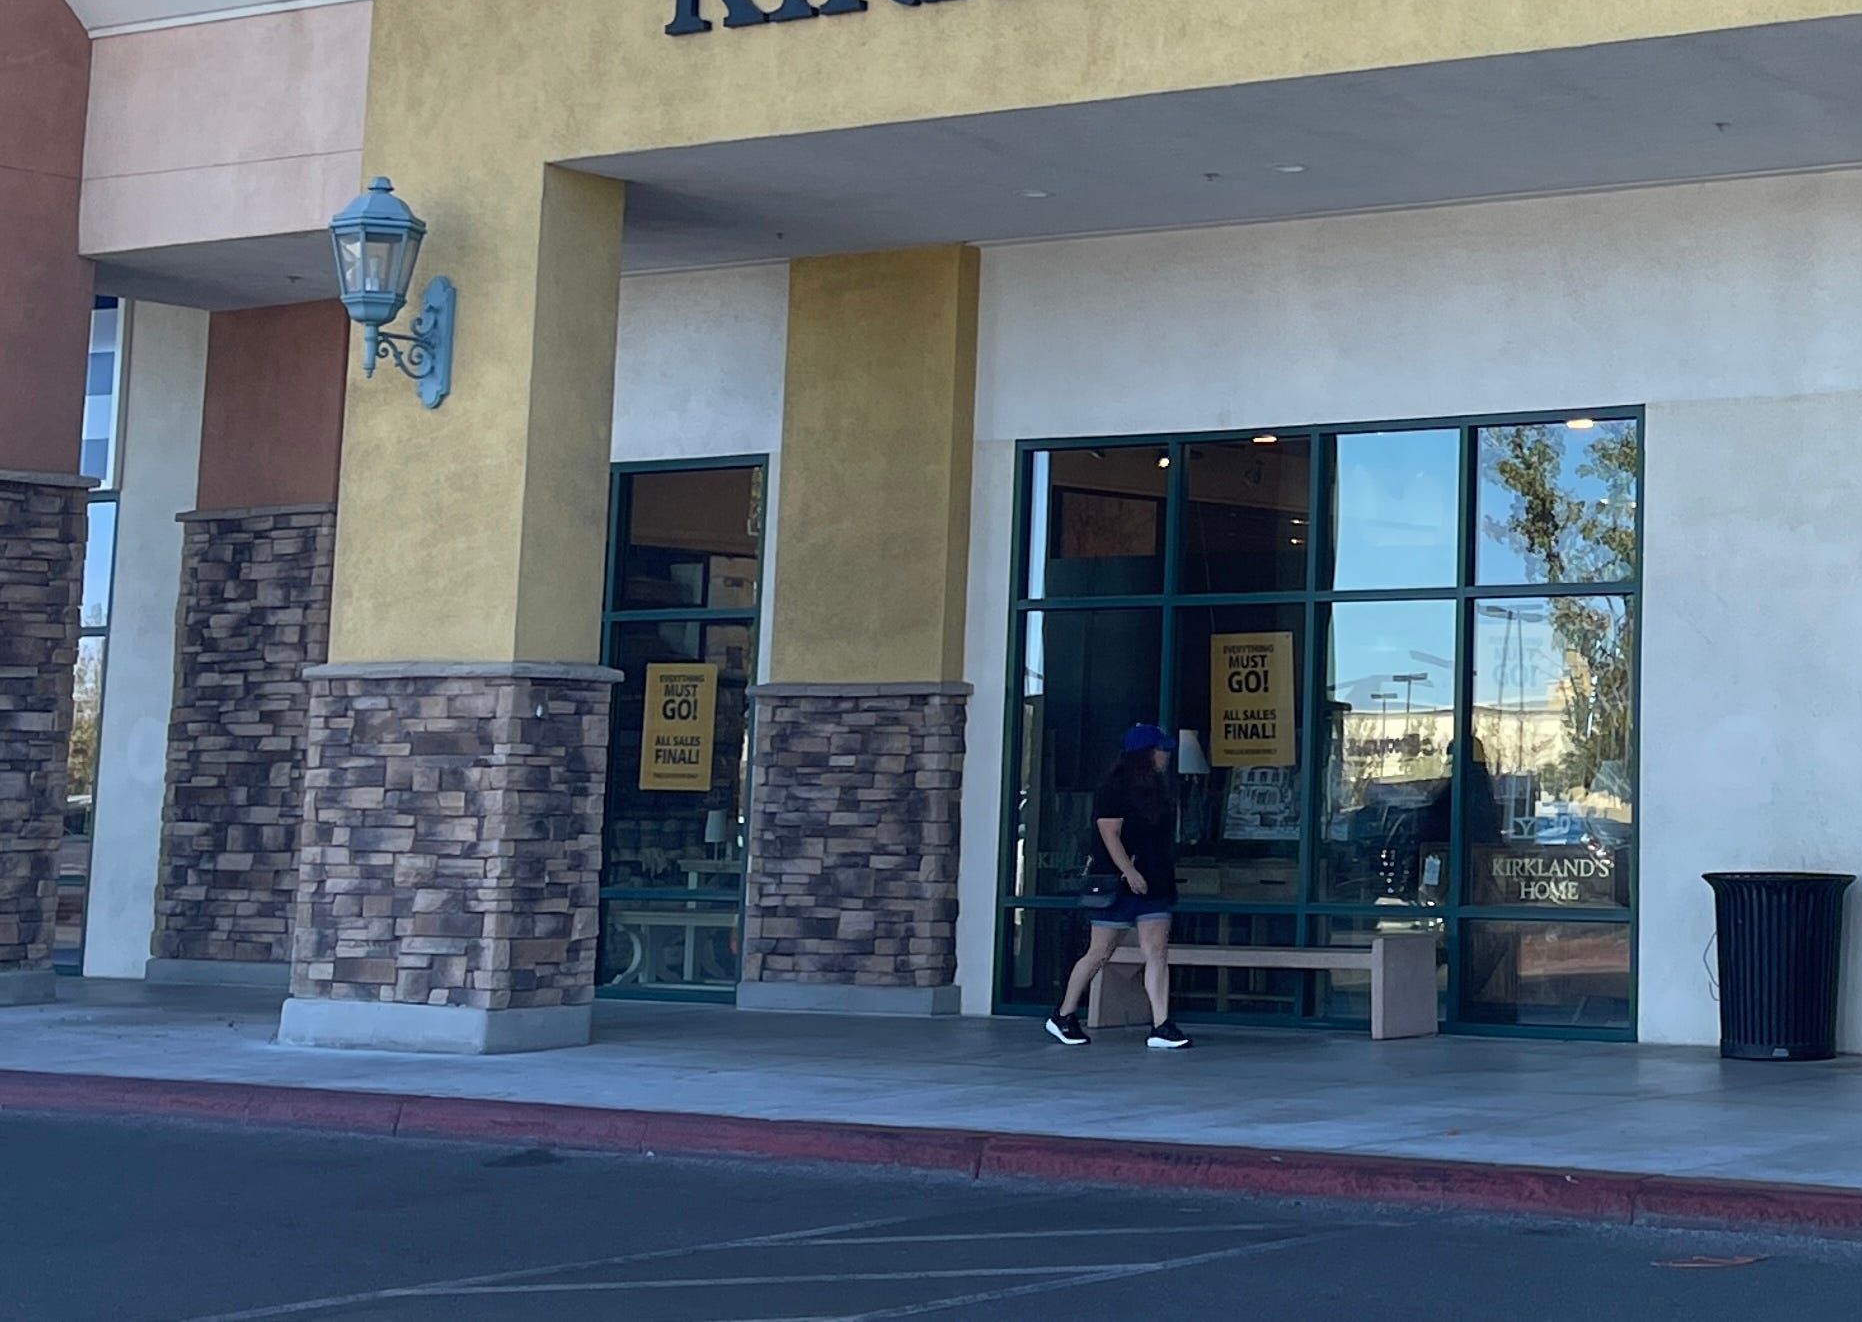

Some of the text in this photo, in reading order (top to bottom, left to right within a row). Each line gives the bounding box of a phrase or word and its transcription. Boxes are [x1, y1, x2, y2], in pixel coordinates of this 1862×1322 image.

[1229, 655, 1268, 669] MUST
[1228, 670, 1269, 693] GO!
[663, 684, 698, 698] MUST
[662, 698, 698, 720] GO!
[1223, 708, 1277, 721] ALL SALES
[1224, 723, 1277, 740] FINAL!
[655, 735, 701, 747] ALL SALES
[655, 749, 699, 765] FINAL!
[1520, 881, 1580, 901] HOME
